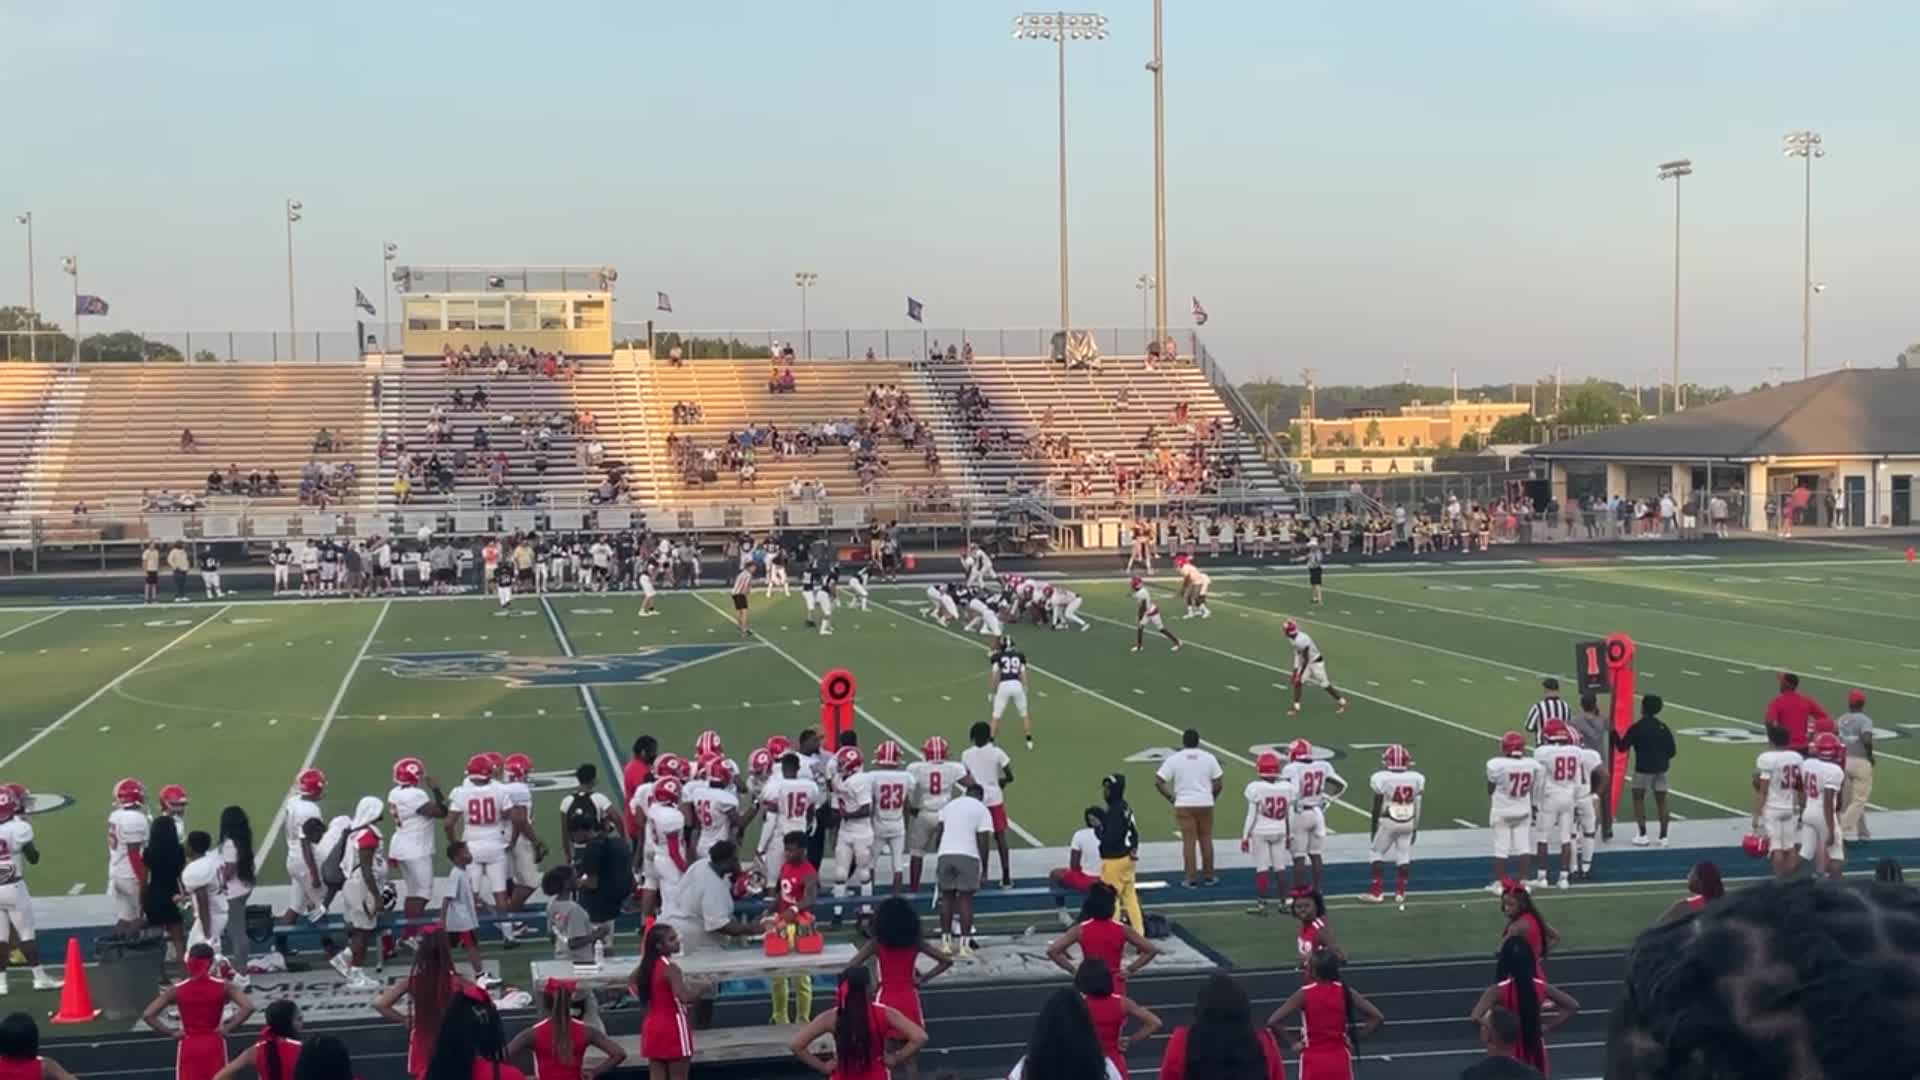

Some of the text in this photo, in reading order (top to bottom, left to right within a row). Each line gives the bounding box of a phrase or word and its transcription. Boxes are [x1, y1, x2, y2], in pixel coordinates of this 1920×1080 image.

[1001, 656, 1020, 674] 39
[1585, 647, 1600, 675] 1
[1554, 756, 1577, 781] 89
[930, 771, 941, 795] 8
[1303, 771, 1323, 797] 27
[1509, 772, 1531, 797] 72
[787, 792, 807, 819] 15
[880, 784, 904, 810] 23
[1263, 796, 1287, 820] 32
[468, 797, 496, 826] 90
